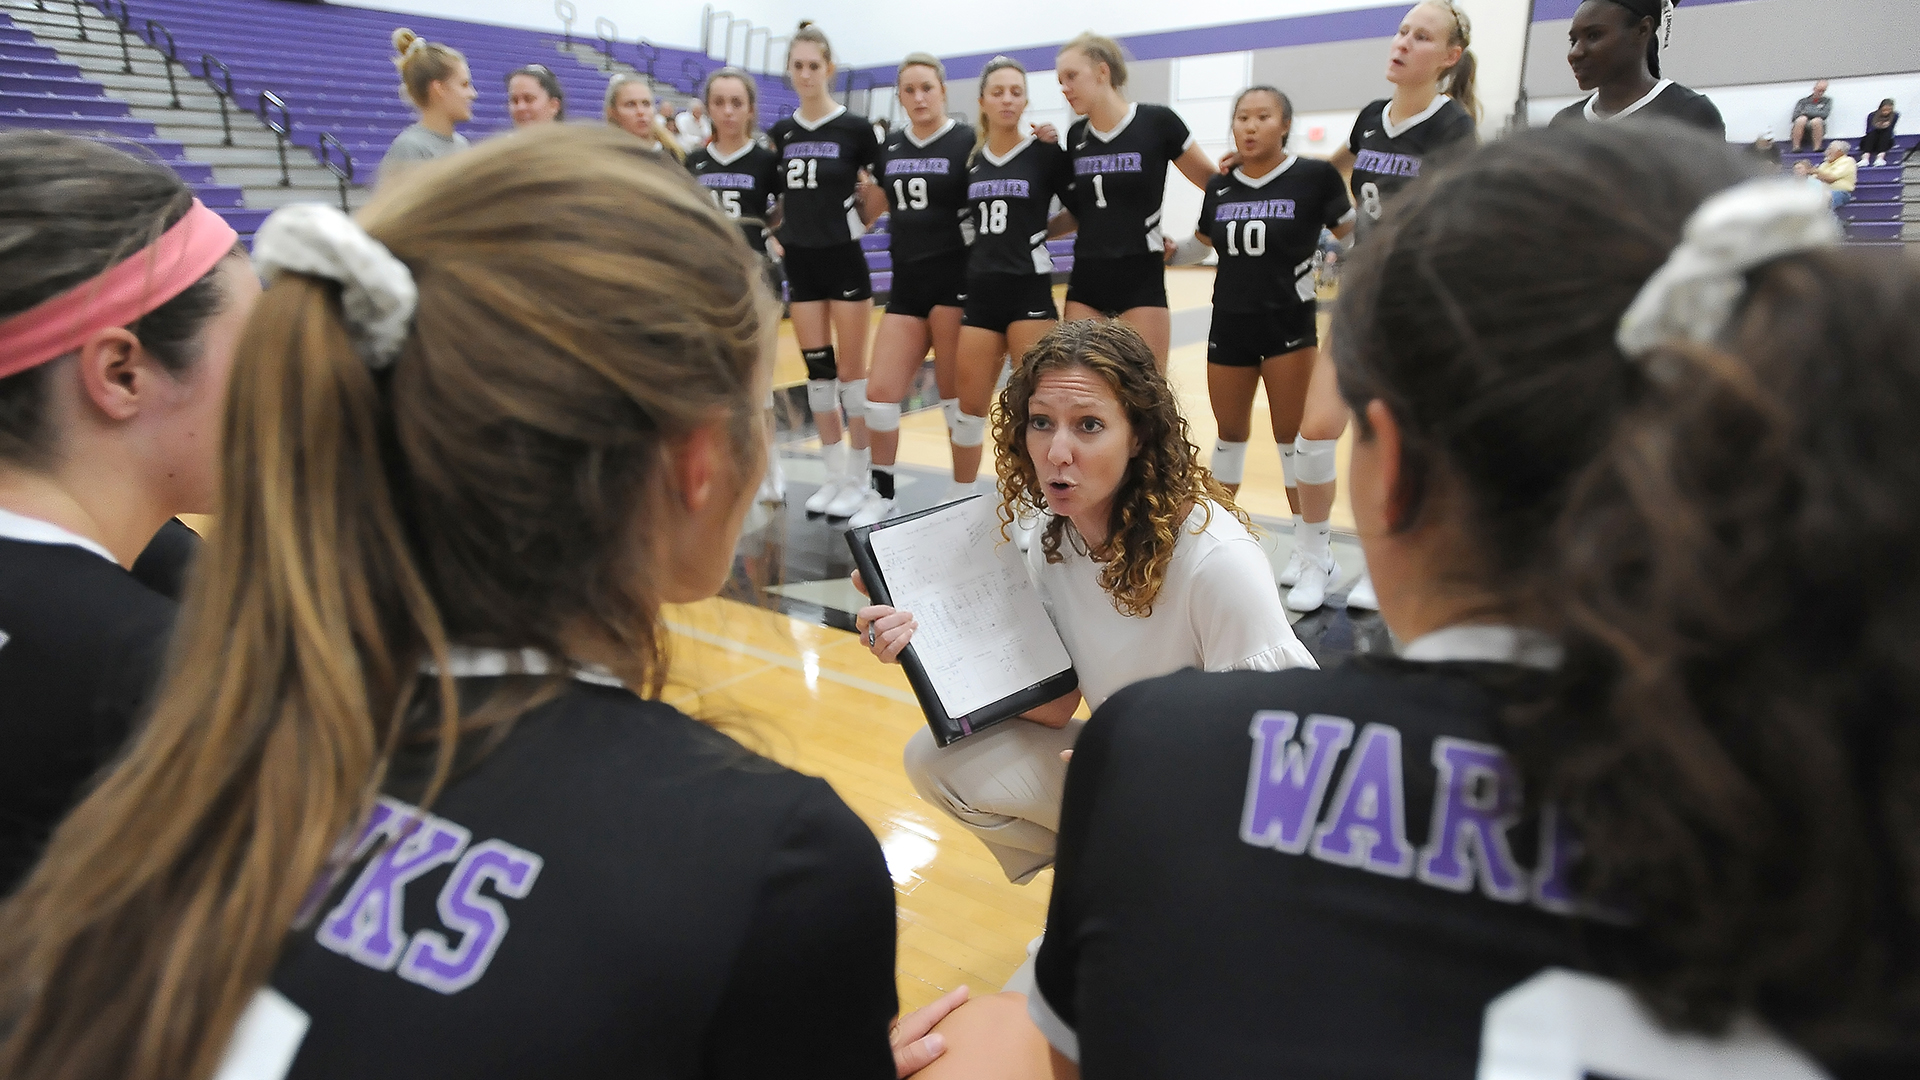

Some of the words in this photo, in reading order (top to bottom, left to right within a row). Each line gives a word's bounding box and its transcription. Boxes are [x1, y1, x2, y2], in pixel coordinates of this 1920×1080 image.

[786, 158, 819, 189] 21
[892, 177, 929, 211] 19
[1092, 174, 1108, 209] 1
[1361, 182, 1382, 220] 8
[978, 199, 1008, 235] 18
[1214, 199, 1296, 222] TEWATER
[1226, 220, 1267, 257] 10
